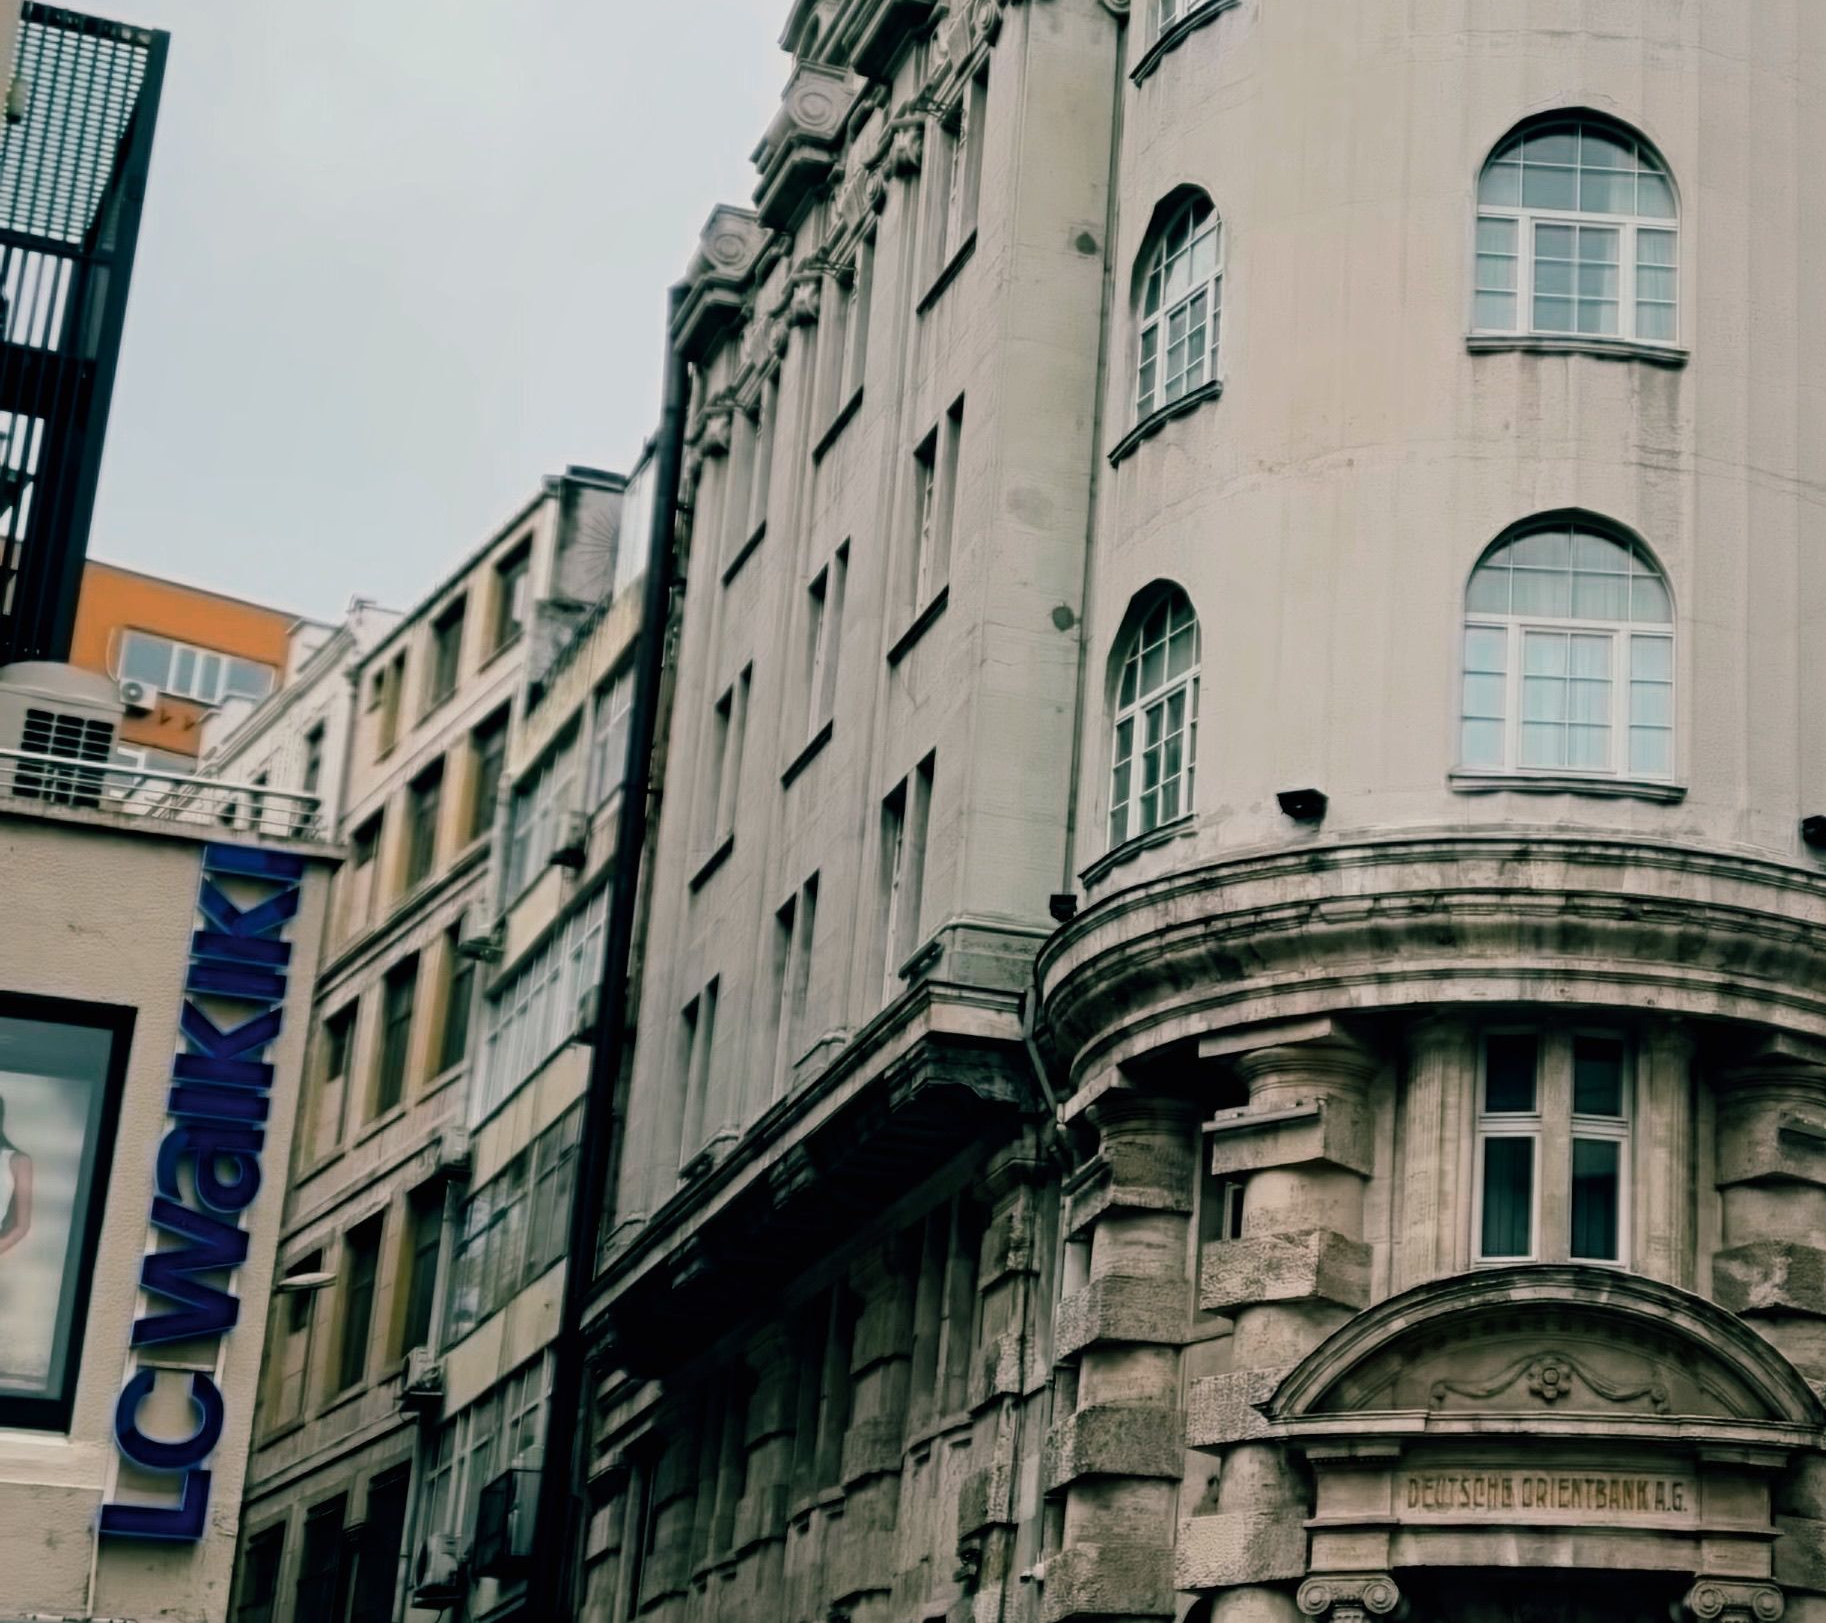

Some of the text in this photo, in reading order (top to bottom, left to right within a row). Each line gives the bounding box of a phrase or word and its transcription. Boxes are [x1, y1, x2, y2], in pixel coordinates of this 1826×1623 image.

[98, 1367, 227, 1542] LC
[1407, 1477, 1688, 1512] DEUTSCHE ORIENTBANK A.G.
